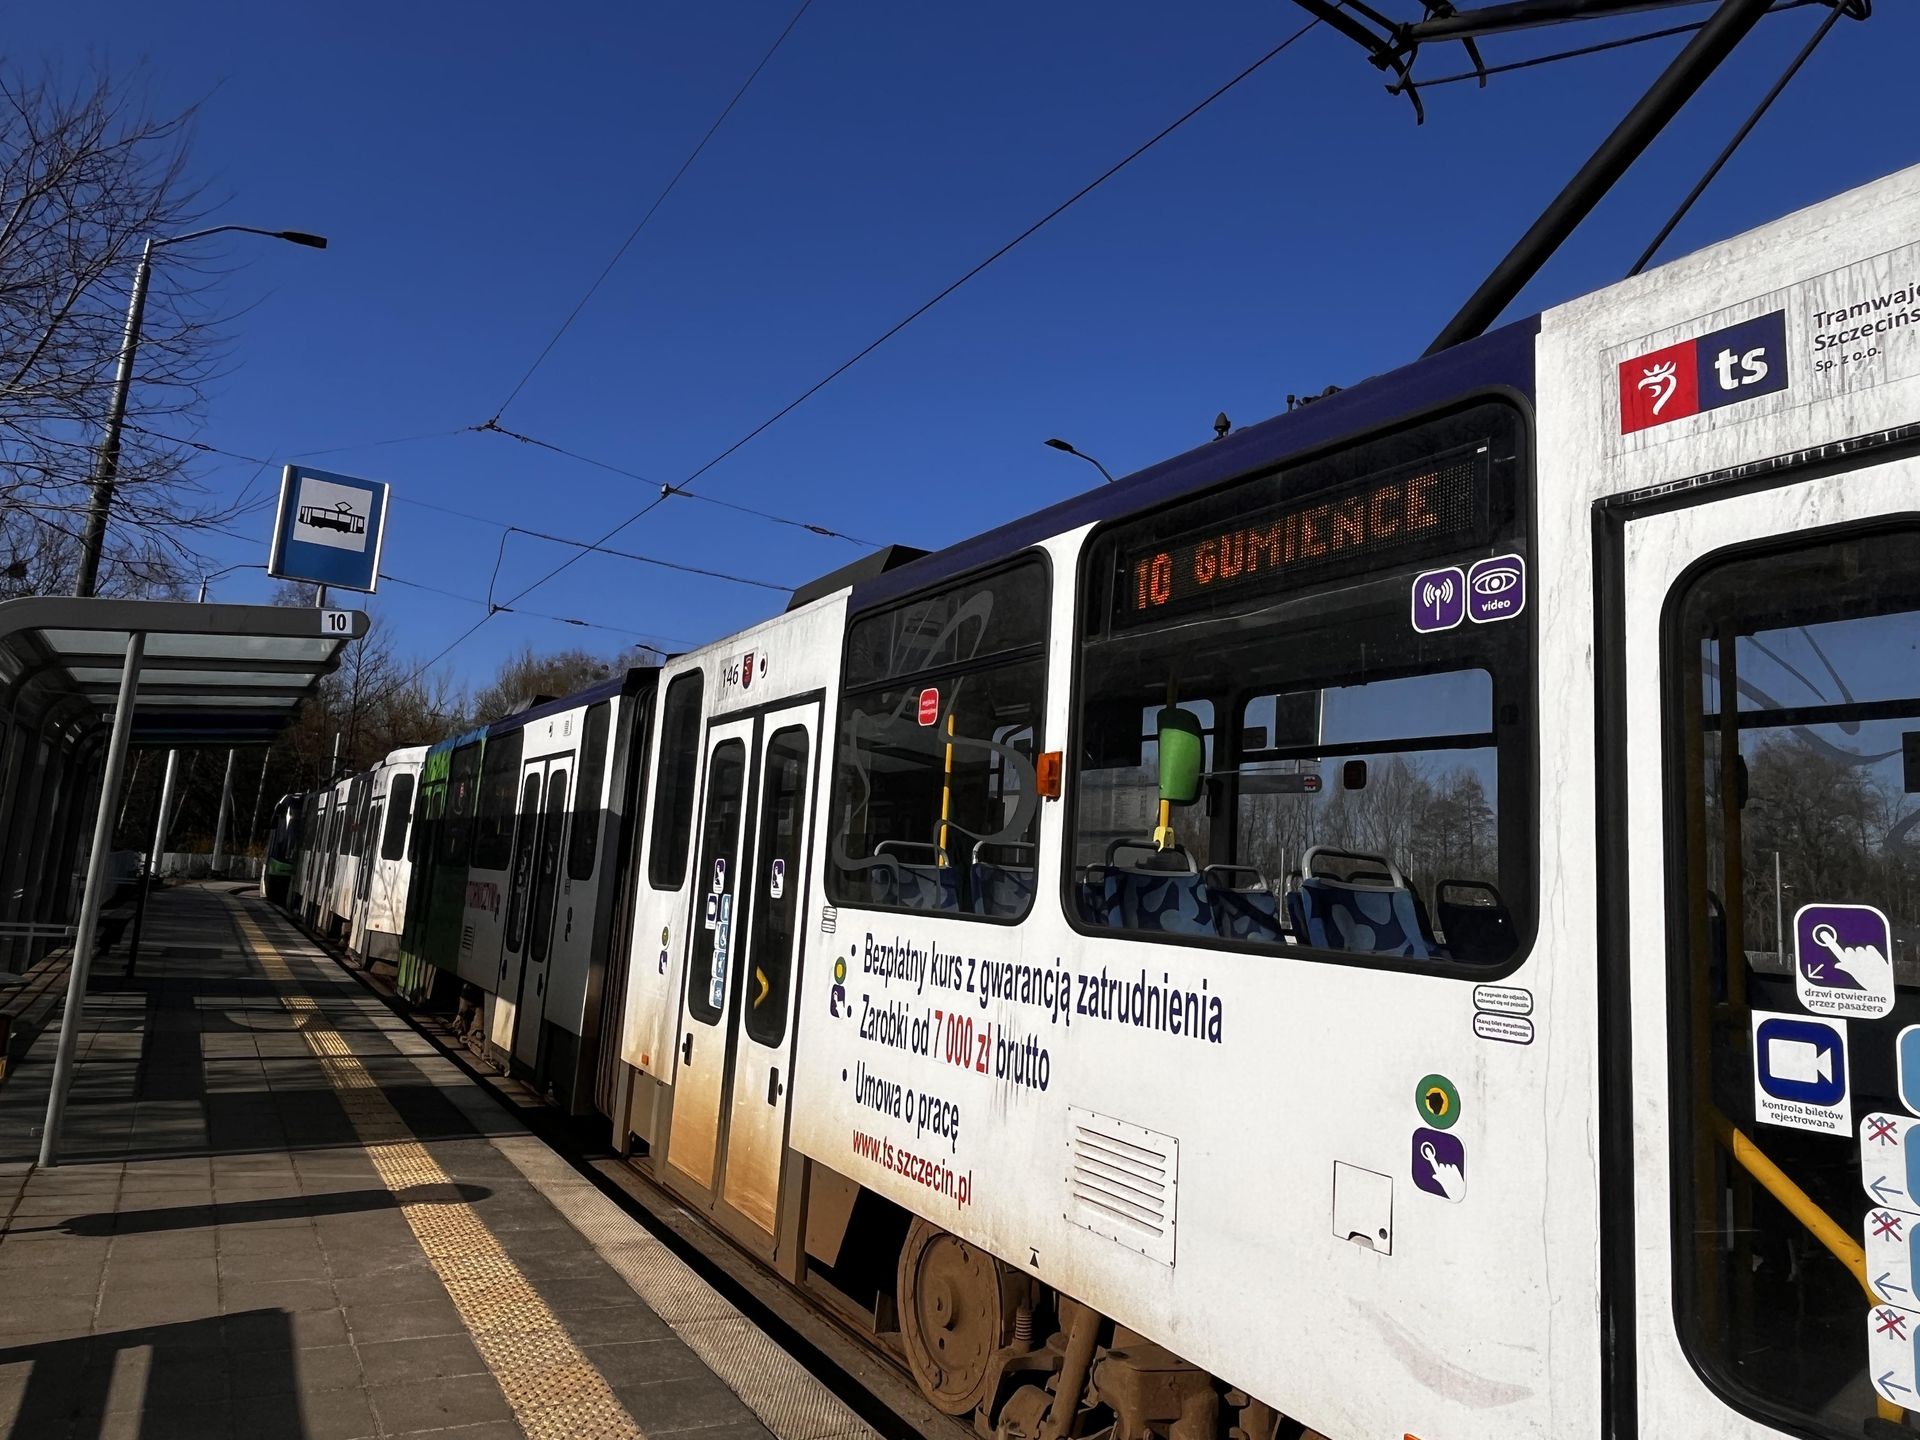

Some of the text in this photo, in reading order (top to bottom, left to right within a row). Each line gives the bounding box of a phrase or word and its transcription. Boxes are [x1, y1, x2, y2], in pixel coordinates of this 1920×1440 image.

[1714, 346, 1769, 391] ts
[1815, 347, 1882, 373] Sp. z o.o.
[1134, 553, 1173, 610] 10
[1481, 599, 1511, 612] video
[328, 613, 347, 631] 10
[722, 663, 739, 689] 146
[863, 932, 1223, 1044] Bezpłatny kurs z gwarancją zatrudnienia
[1804, 987, 1887, 1004] drzwi otwierane
[1808, 999, 1884, 1013] przez pasażera
[859, 993, 909, 1050] Zarobki
[911, 1008, 931, 1056] od
[975, 1022, 992, 1075] zł
[995, 1024, 1050, 1092] brutto
[855, 1060, 960, 1155] Umowa o pracę
[1761, 1099, 1844, 1121] kontrola biletów
[1770, 1111, 1836, 1130] rejestrowana
[852, 1129, 972, 1211] www.ts.szczecin.pl
